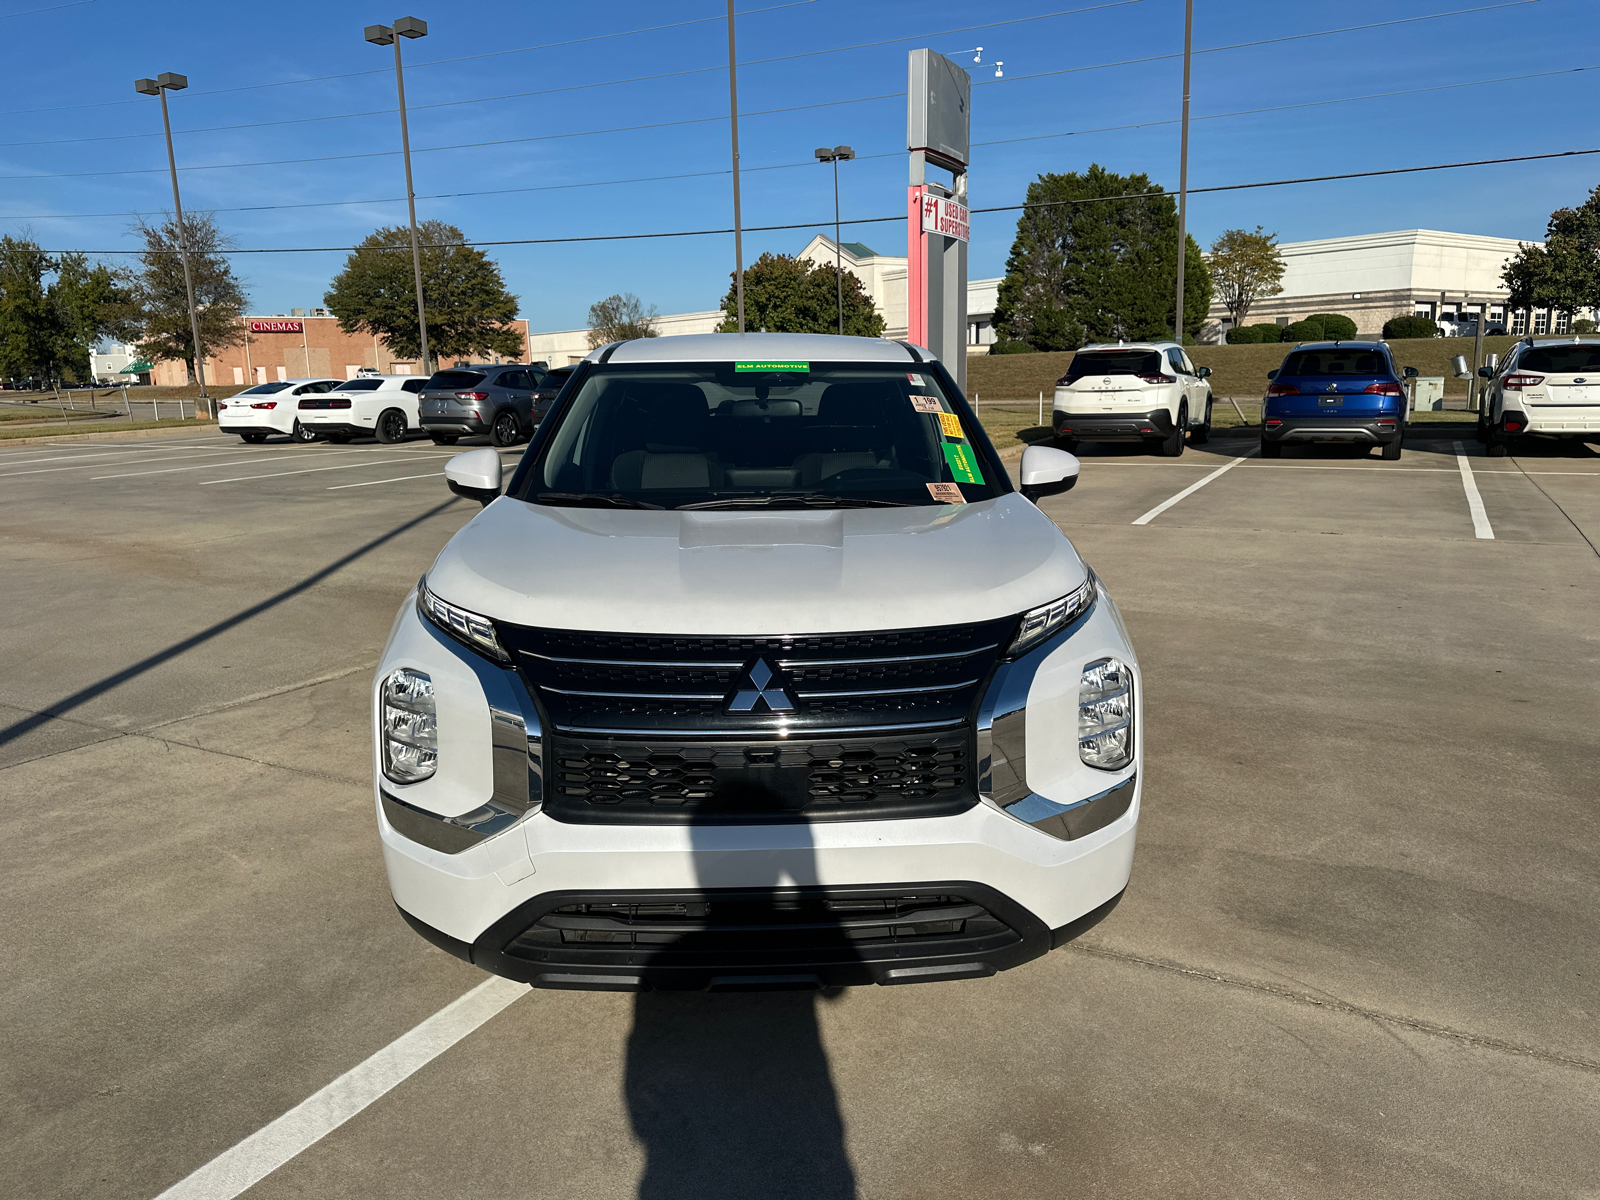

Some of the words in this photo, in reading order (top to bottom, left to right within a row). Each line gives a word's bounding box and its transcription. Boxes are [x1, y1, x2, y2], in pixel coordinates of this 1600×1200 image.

[924, 197, 938, 230] #1
[944, 201, 958, 220] USED
[940, 216, 970, 241] SUPERSTORE
[252, 322, 299, 331] CINEMAS
